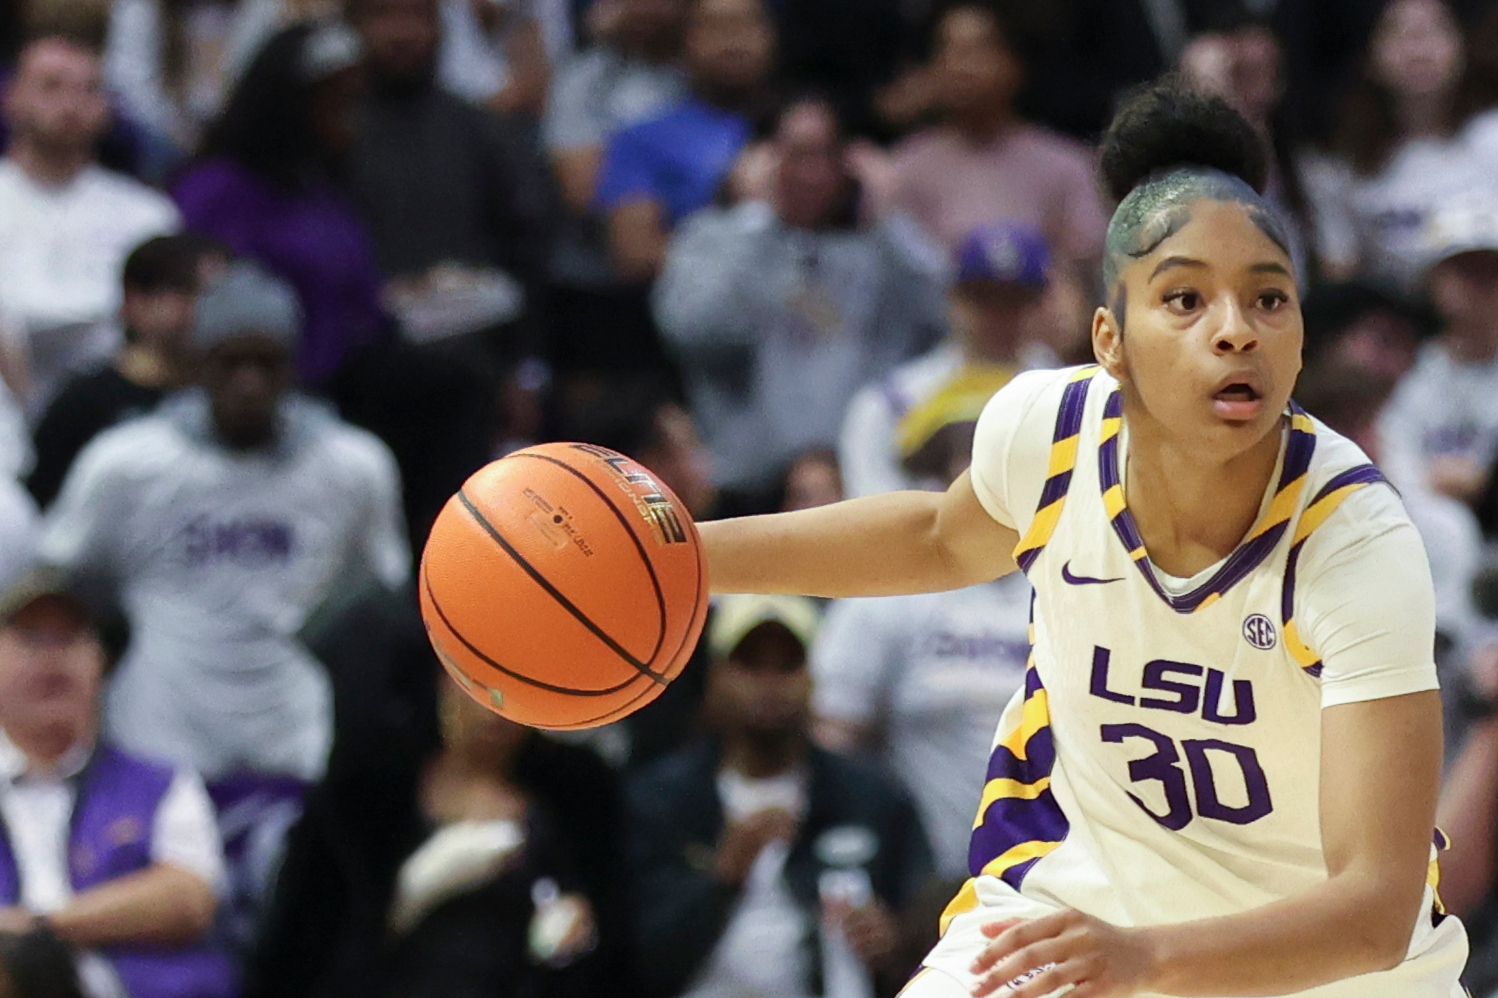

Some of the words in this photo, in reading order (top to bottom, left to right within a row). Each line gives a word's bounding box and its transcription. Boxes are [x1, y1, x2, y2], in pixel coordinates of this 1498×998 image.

[1247, 617, 1273, 646] SEC
[1089, 645, 1256, 725] LSU
[1100, 723, 1273, 831] 30
